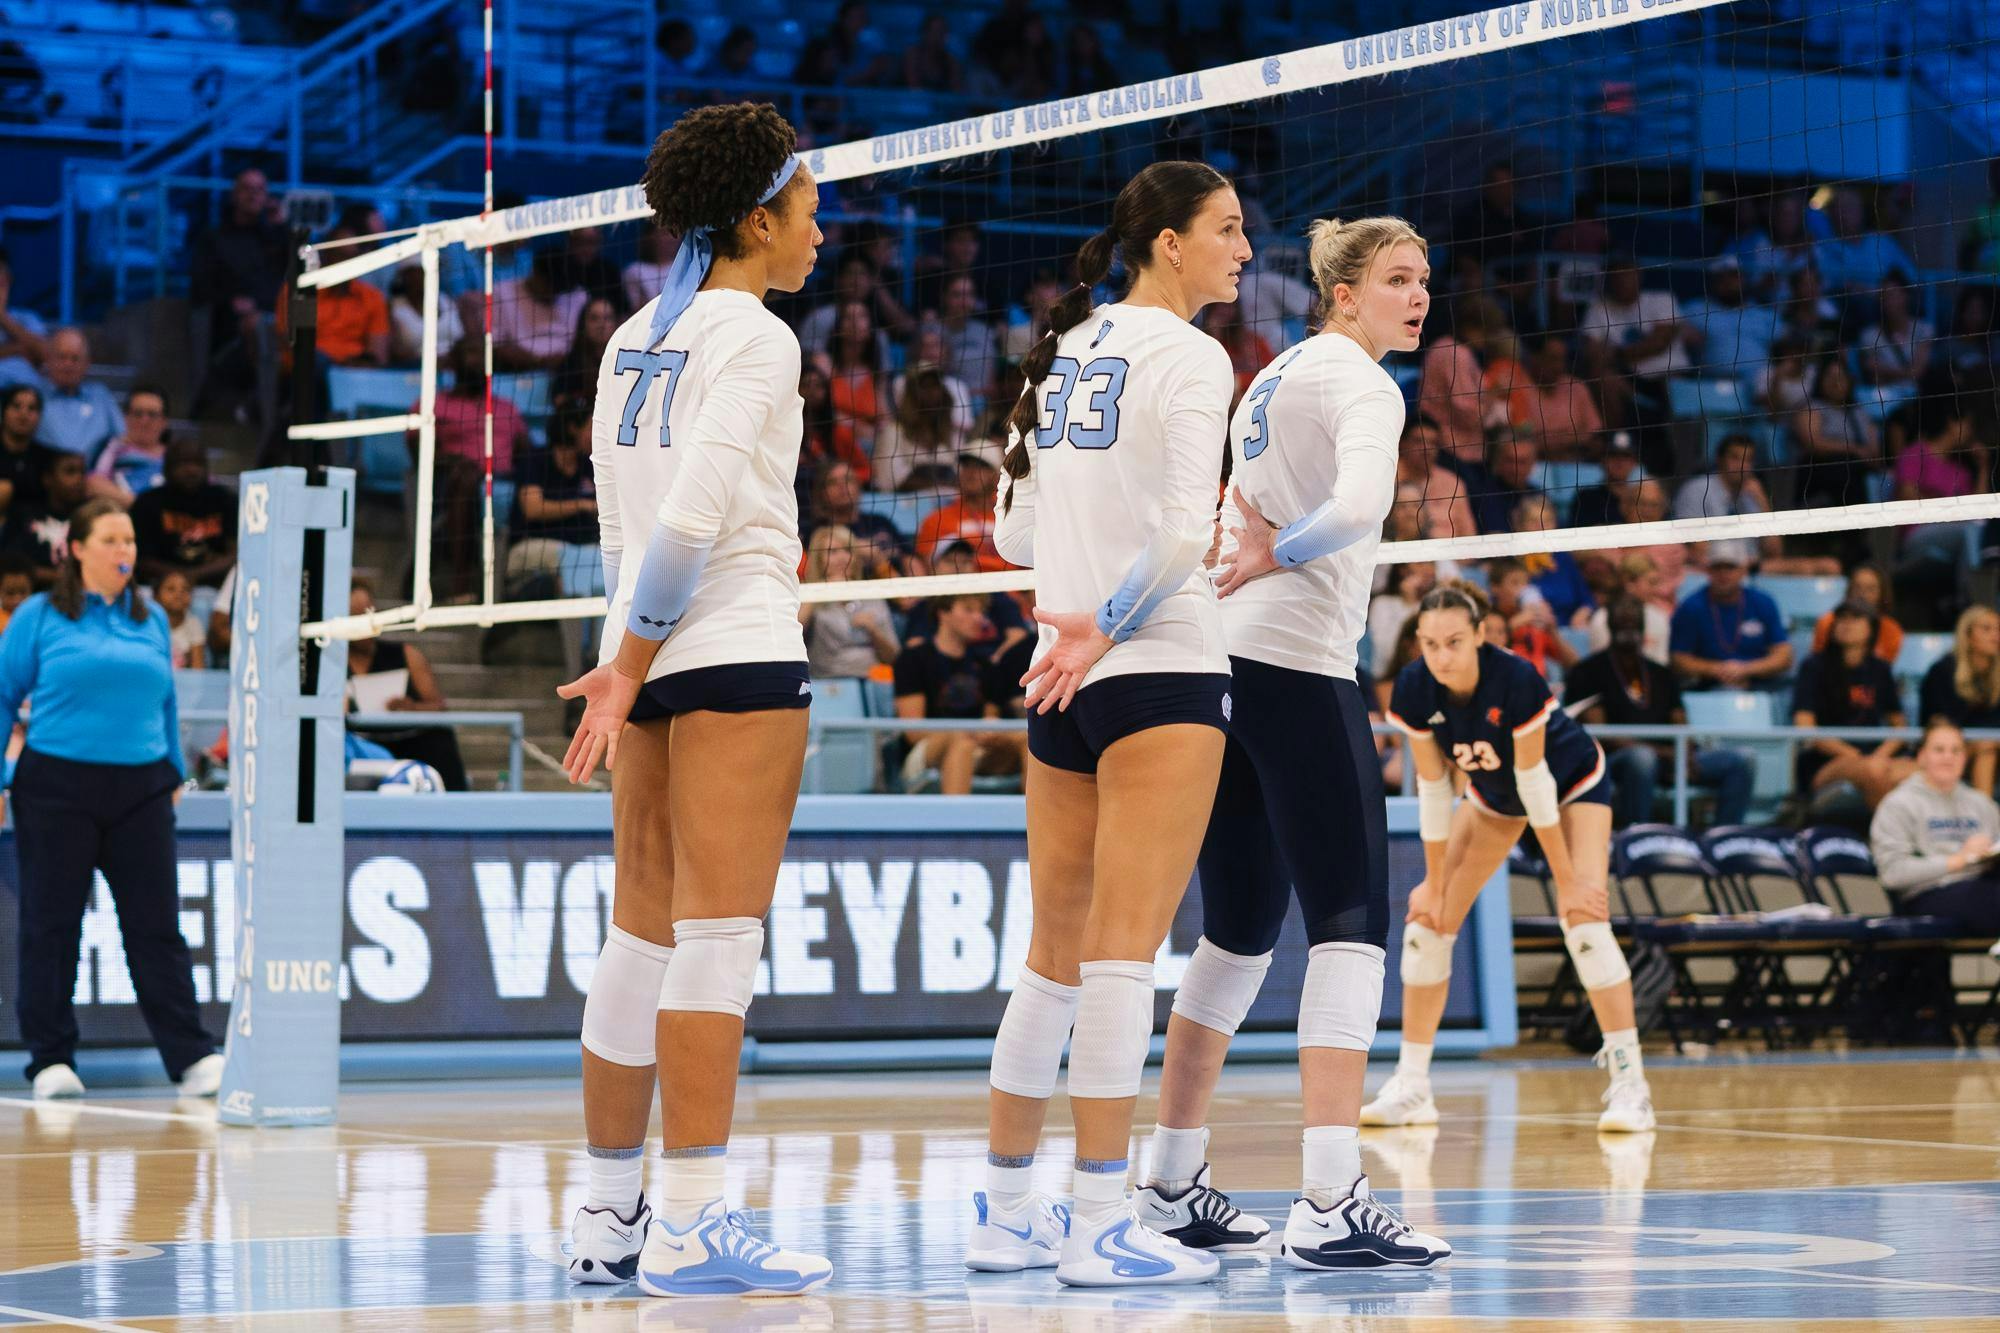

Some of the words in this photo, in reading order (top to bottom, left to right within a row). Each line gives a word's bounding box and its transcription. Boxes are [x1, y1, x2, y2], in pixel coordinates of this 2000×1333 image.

[1343, 12, 1490, 70] UNIVERSITY
[1499, 5, 1530, 38] OF
[872, 118, 984, 163] UNIVERSITY
[992, 111, 1016, 140] OF
[1024, 99, 1092, 133] NORTH
[1098, 72, 1203, 118] CAROLINA
[614, 348, 690, 448] 77
[1034, 356, 1129, 450] 33
[1243, 375, 1282, 461] 3
[1453, 740, 1502, 772] 23
[237, 577, 261, 1038] CAROLINA
[472, 856, 1193, 999] VOEYB
[265, 960, 333, 993] UNC
